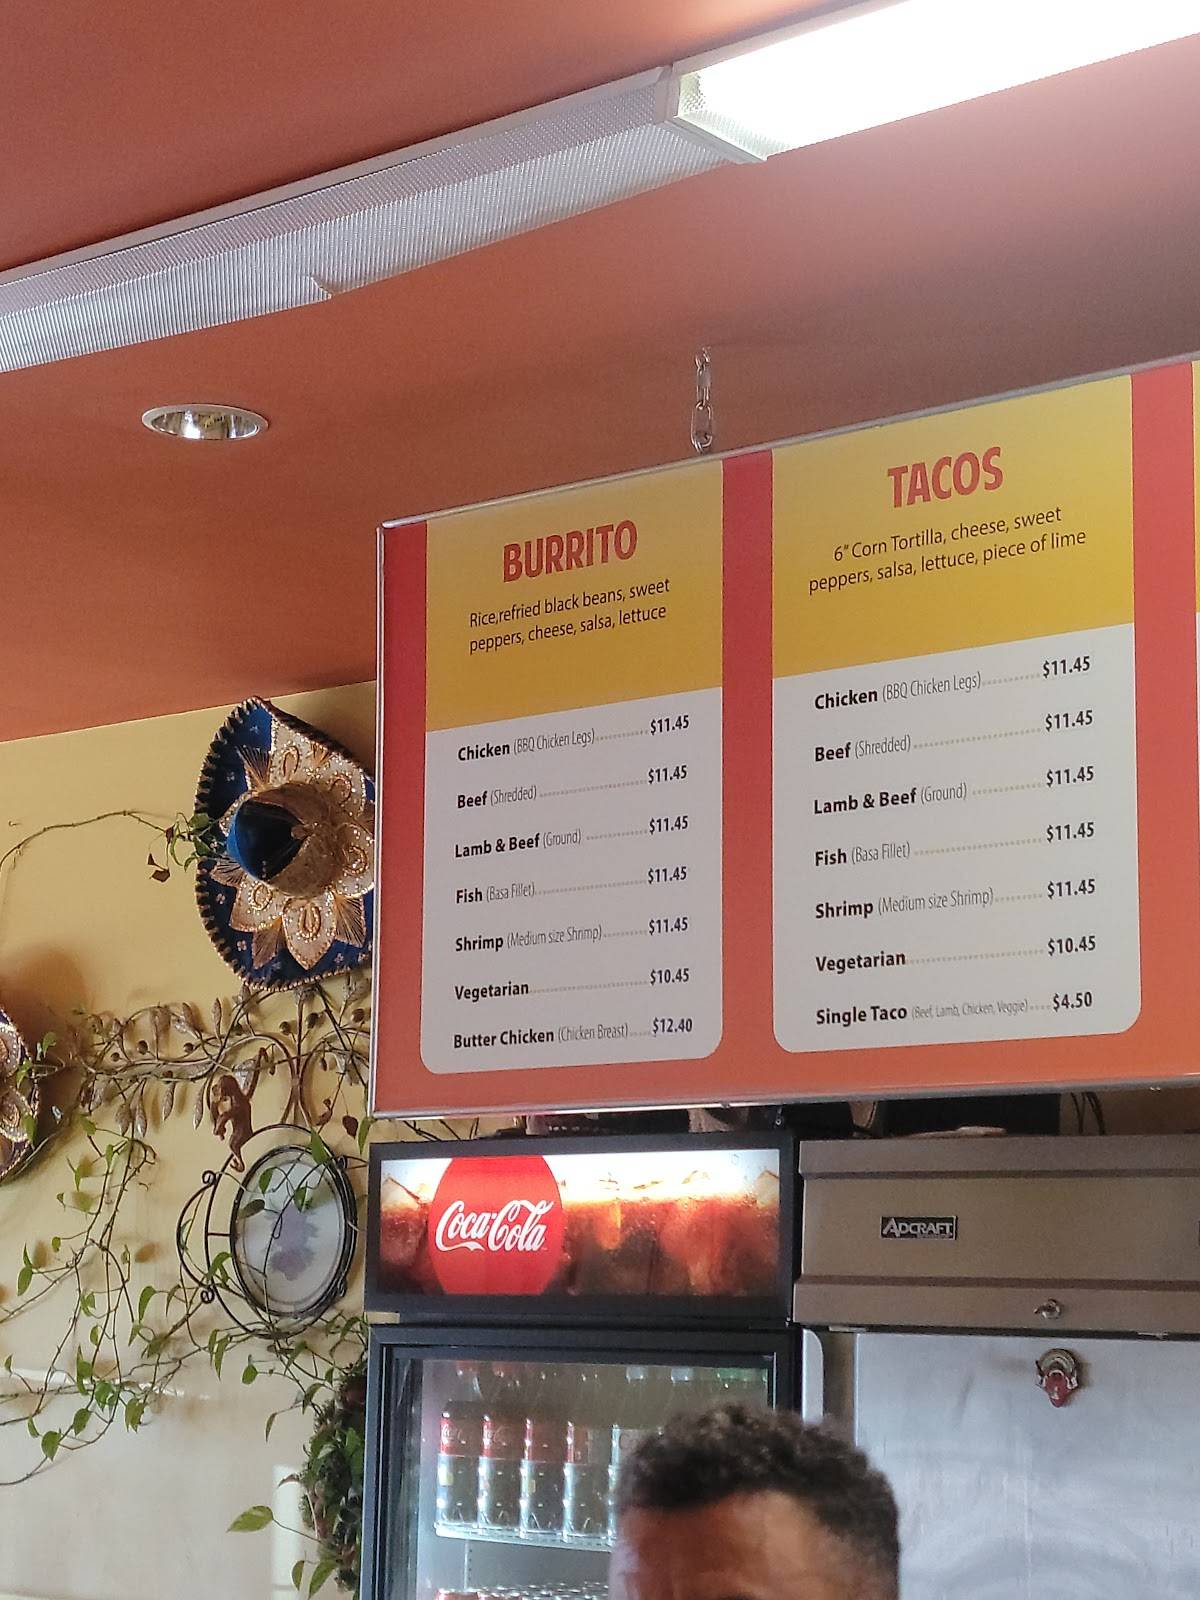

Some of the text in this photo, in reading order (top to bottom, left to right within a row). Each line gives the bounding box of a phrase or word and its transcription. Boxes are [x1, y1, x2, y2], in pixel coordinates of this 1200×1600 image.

[888, 446, 1003, 508] TACOS
[503, 520, 637, 582] BURRITO
[852, 540, 887, 559] Corn
[891, 528, 946, 553] Tortilla,
[951, 518, 1010, 541] cheese,
[1014, 508, 1062, 529] sweet
[809, 531, 1086, 595] peppers, salsa, lettuce, piece of lime
[544, 594, 579, 614] black
[582, 587, 625, 607] beans,
[630, 579, 670, 598] sweet
[470, 605, 666, 655] peppers, cheese, salsa, lettuce
[815, 655, 1090, 709] Chicken (BBQ Chicken Legs) $11.45
[458, 715, 689, 761] Chicken (BBQ Chicken Legs) $11.45
[815, 710, 1093, 762] Beef (Shredded) $11.45
[457, 765, 687, 809] Beef (Shredded) $11.45
[814, 766, 1094, 815] Lamb & Beef (Ground) $11.45
[455, 815, 688, 858] Lamb & Beef (Ground) $11.45
[815, 822, 1095, 867] Fish (Basa Fillet) $11.45
[456, 866, 687, 904] Fish (Basa Fillet) $11.45
[815, 879, 1096, 922] Shrimp (Medium size Shrimp) $11.45
[455, 935, 503, 952] Shrimp
[507, 932, 547, 950] (Medium
[549, 930, 565, 944] size
[649, 917, 688, 936] $11.45
[816, 936, 1096, 975] Vegetarian $10.45
[455, 968, 690, 1003] Vegetarian $10.45
[816, 1007, 867, 1027] Single
[870, 1005, 908, 1022] Taco
[1052, 991, 1093, 1011] $4.50
[454, 1018, 693, 1050] Butter Chicken (Chicken Breast) $12.40
[882, 1217, 953, 1238] ADCRAFT
